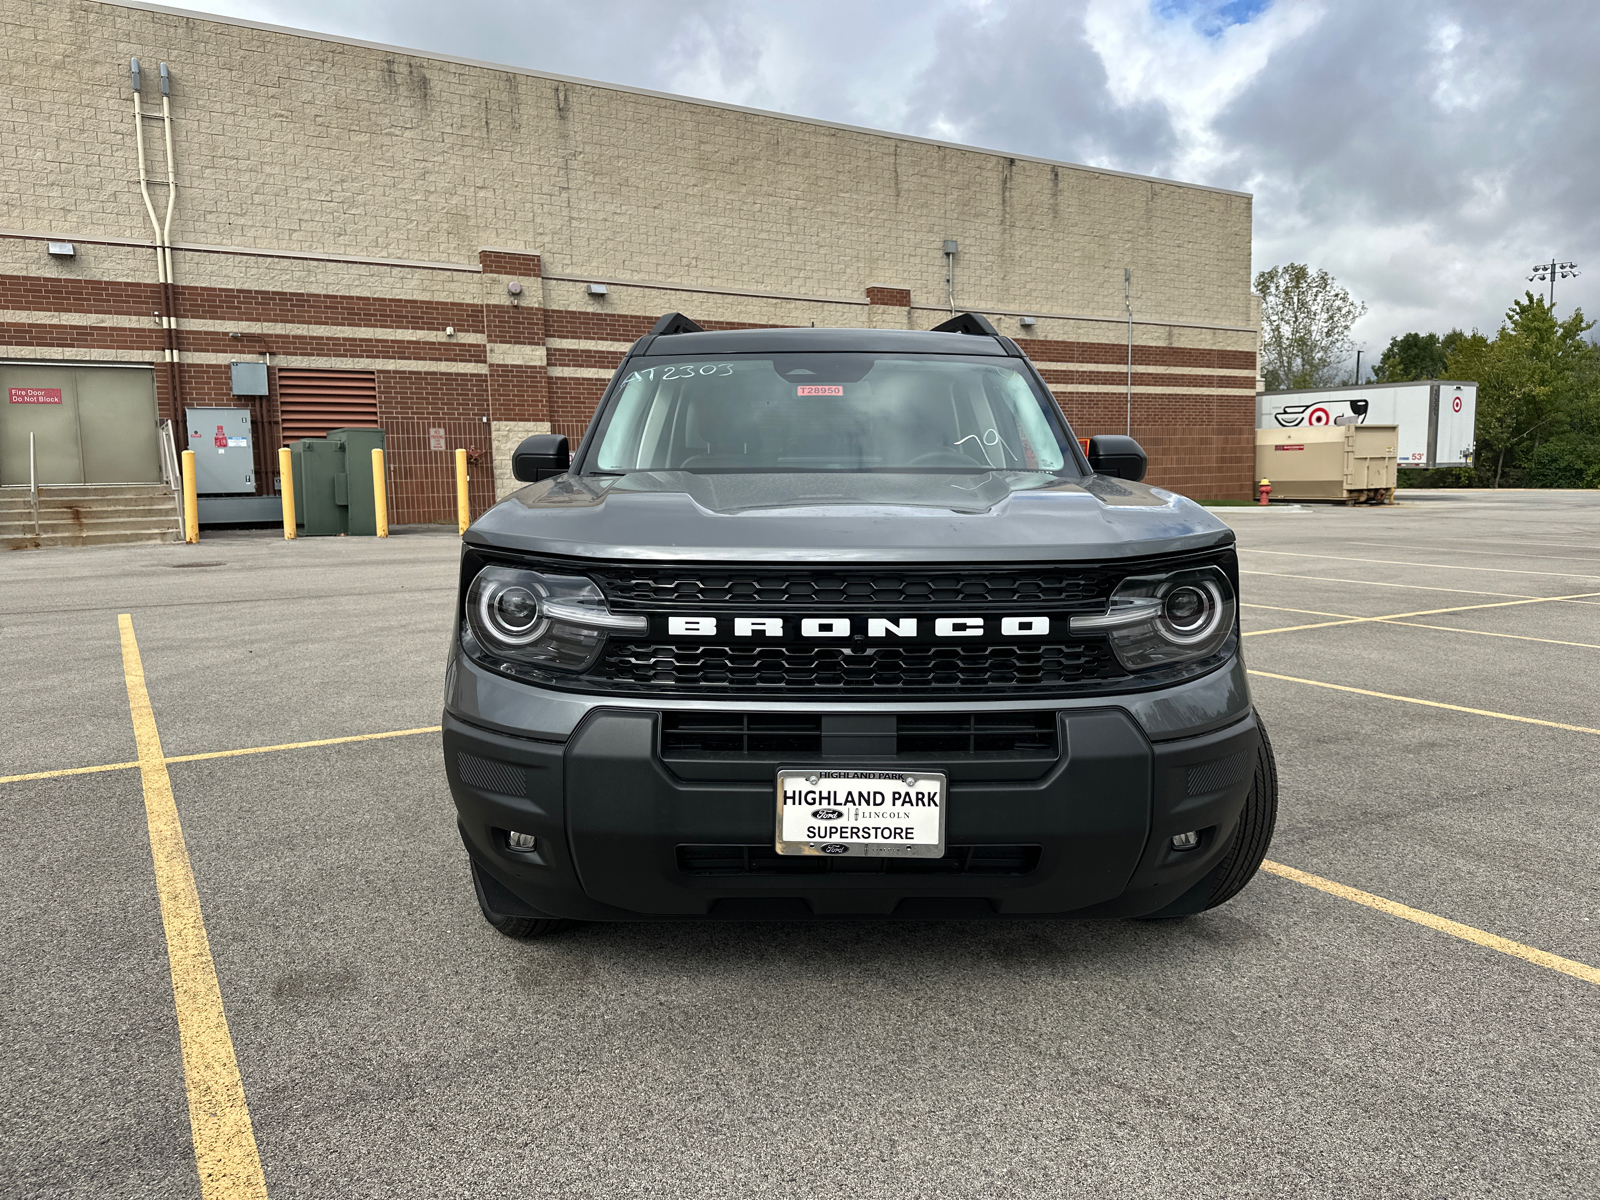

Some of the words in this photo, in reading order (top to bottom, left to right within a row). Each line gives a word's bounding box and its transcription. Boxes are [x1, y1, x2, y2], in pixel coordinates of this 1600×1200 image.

[668, 616, 1050, 637] BRONCO
[819, 771, 876, 780] HIGHLAND
[878, 772, 905, 781] PARK
[783, 790, 886, 807] HIGHLAND
[892, 791, 939, 807] PARK
[861, 811, 911, 819] LINCOLN
[806, 826, 915, 840] SUPERSTORE
